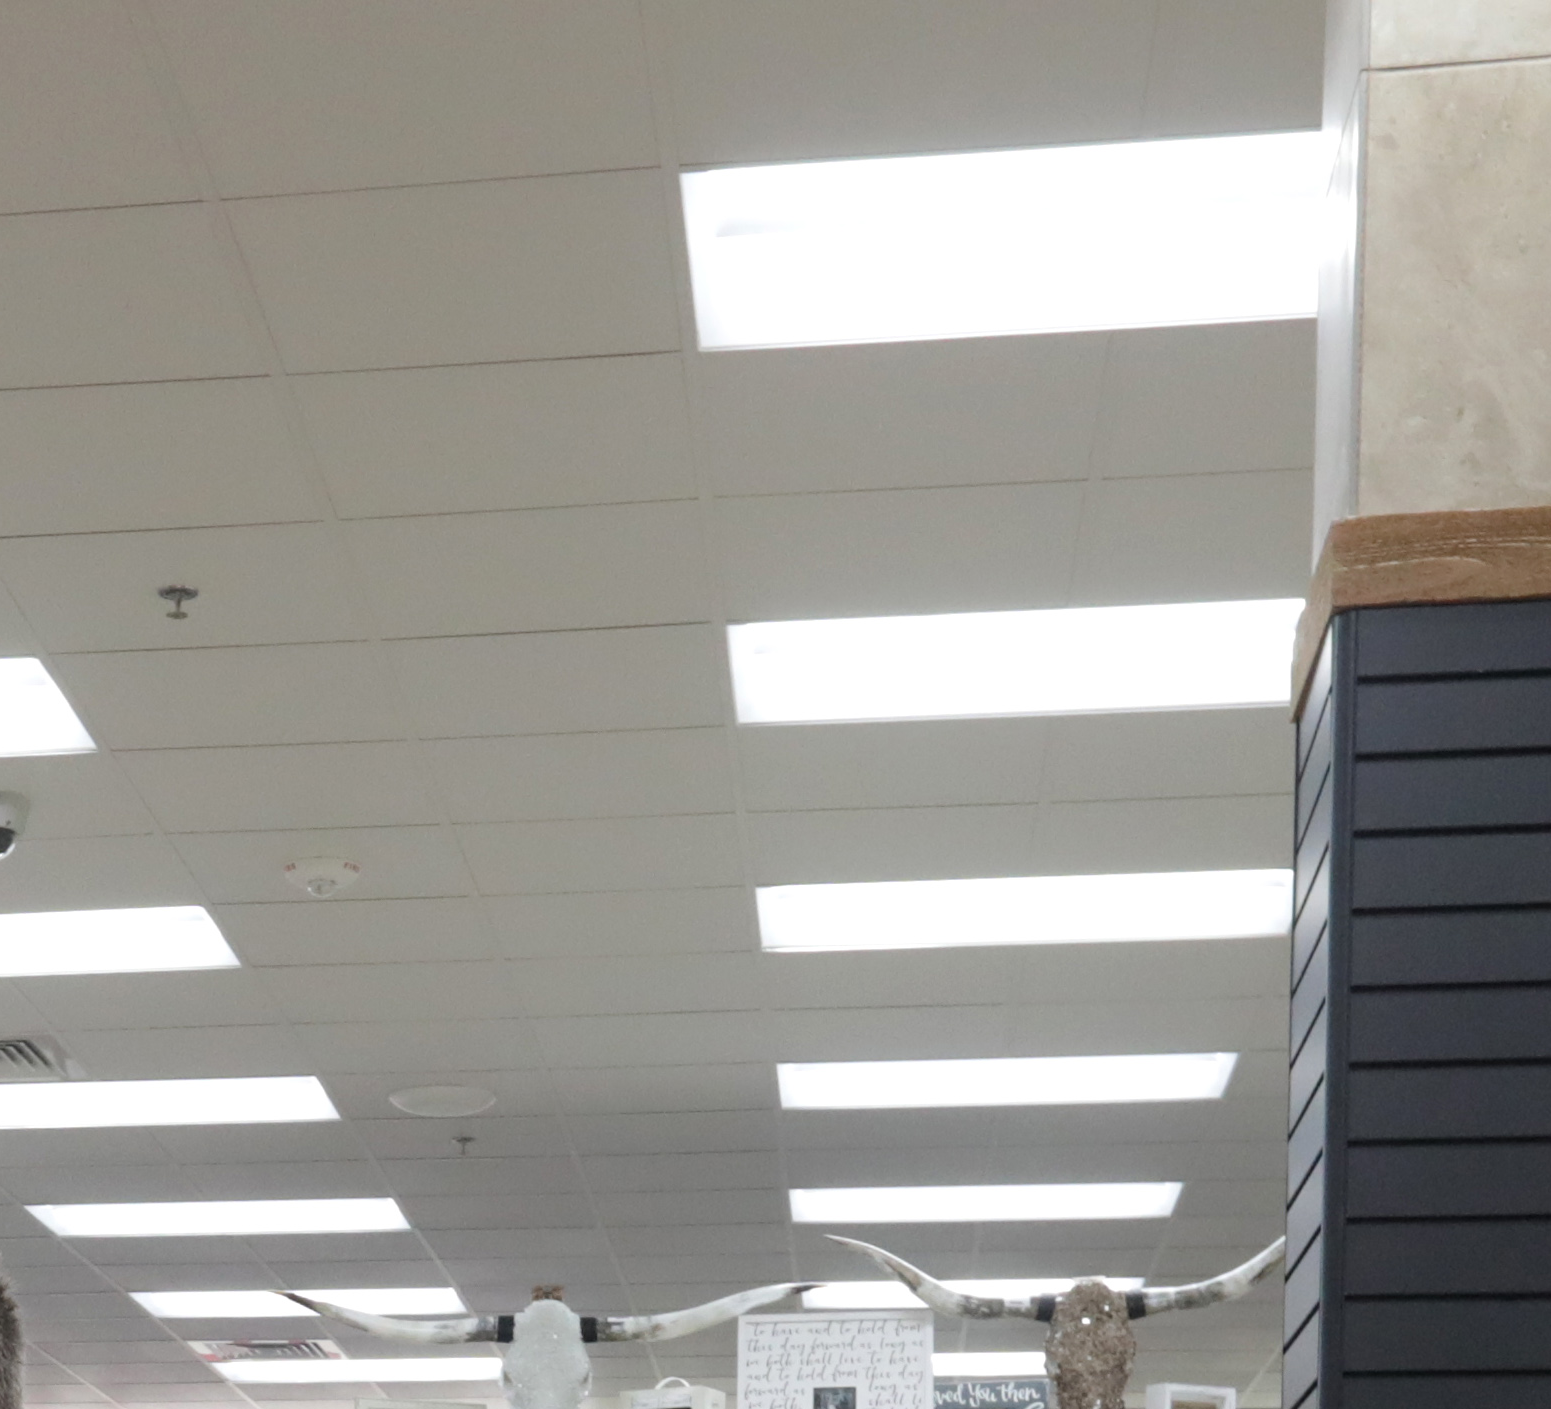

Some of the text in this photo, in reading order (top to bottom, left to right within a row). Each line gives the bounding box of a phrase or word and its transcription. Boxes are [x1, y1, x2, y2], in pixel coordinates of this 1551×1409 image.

[934, 1382, 1040, 1407] ved You then
